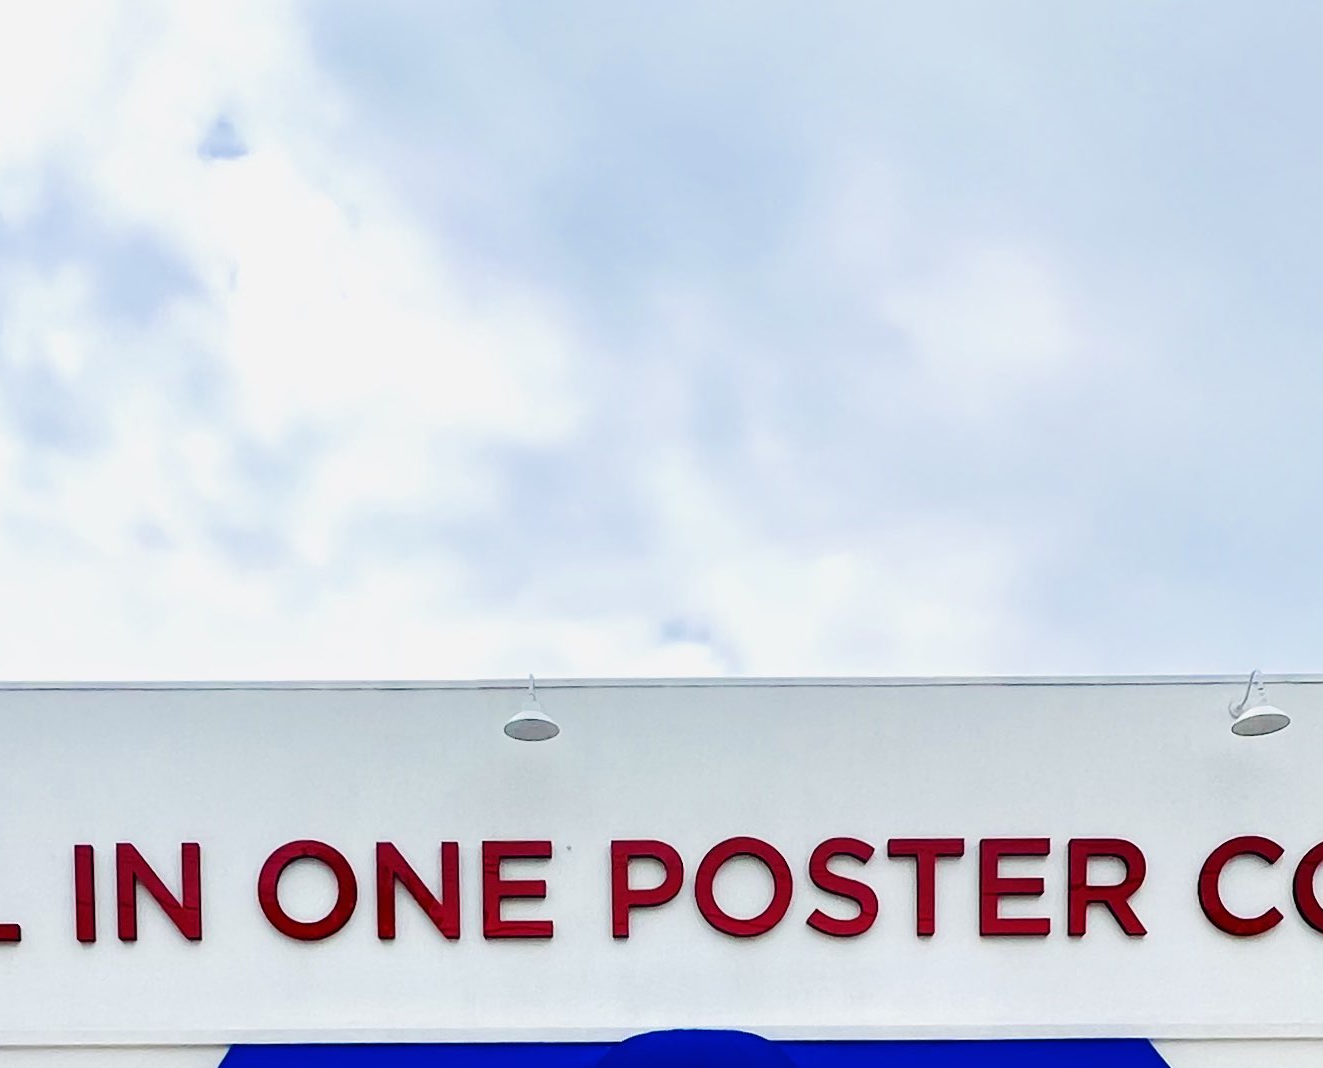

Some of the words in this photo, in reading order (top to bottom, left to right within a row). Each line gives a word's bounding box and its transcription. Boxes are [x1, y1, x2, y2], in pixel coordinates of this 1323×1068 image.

[74, 843, 202, 944] IN
[258, 840, 553, 942] ONE
[611, 837, 1147, 940] POSTER
